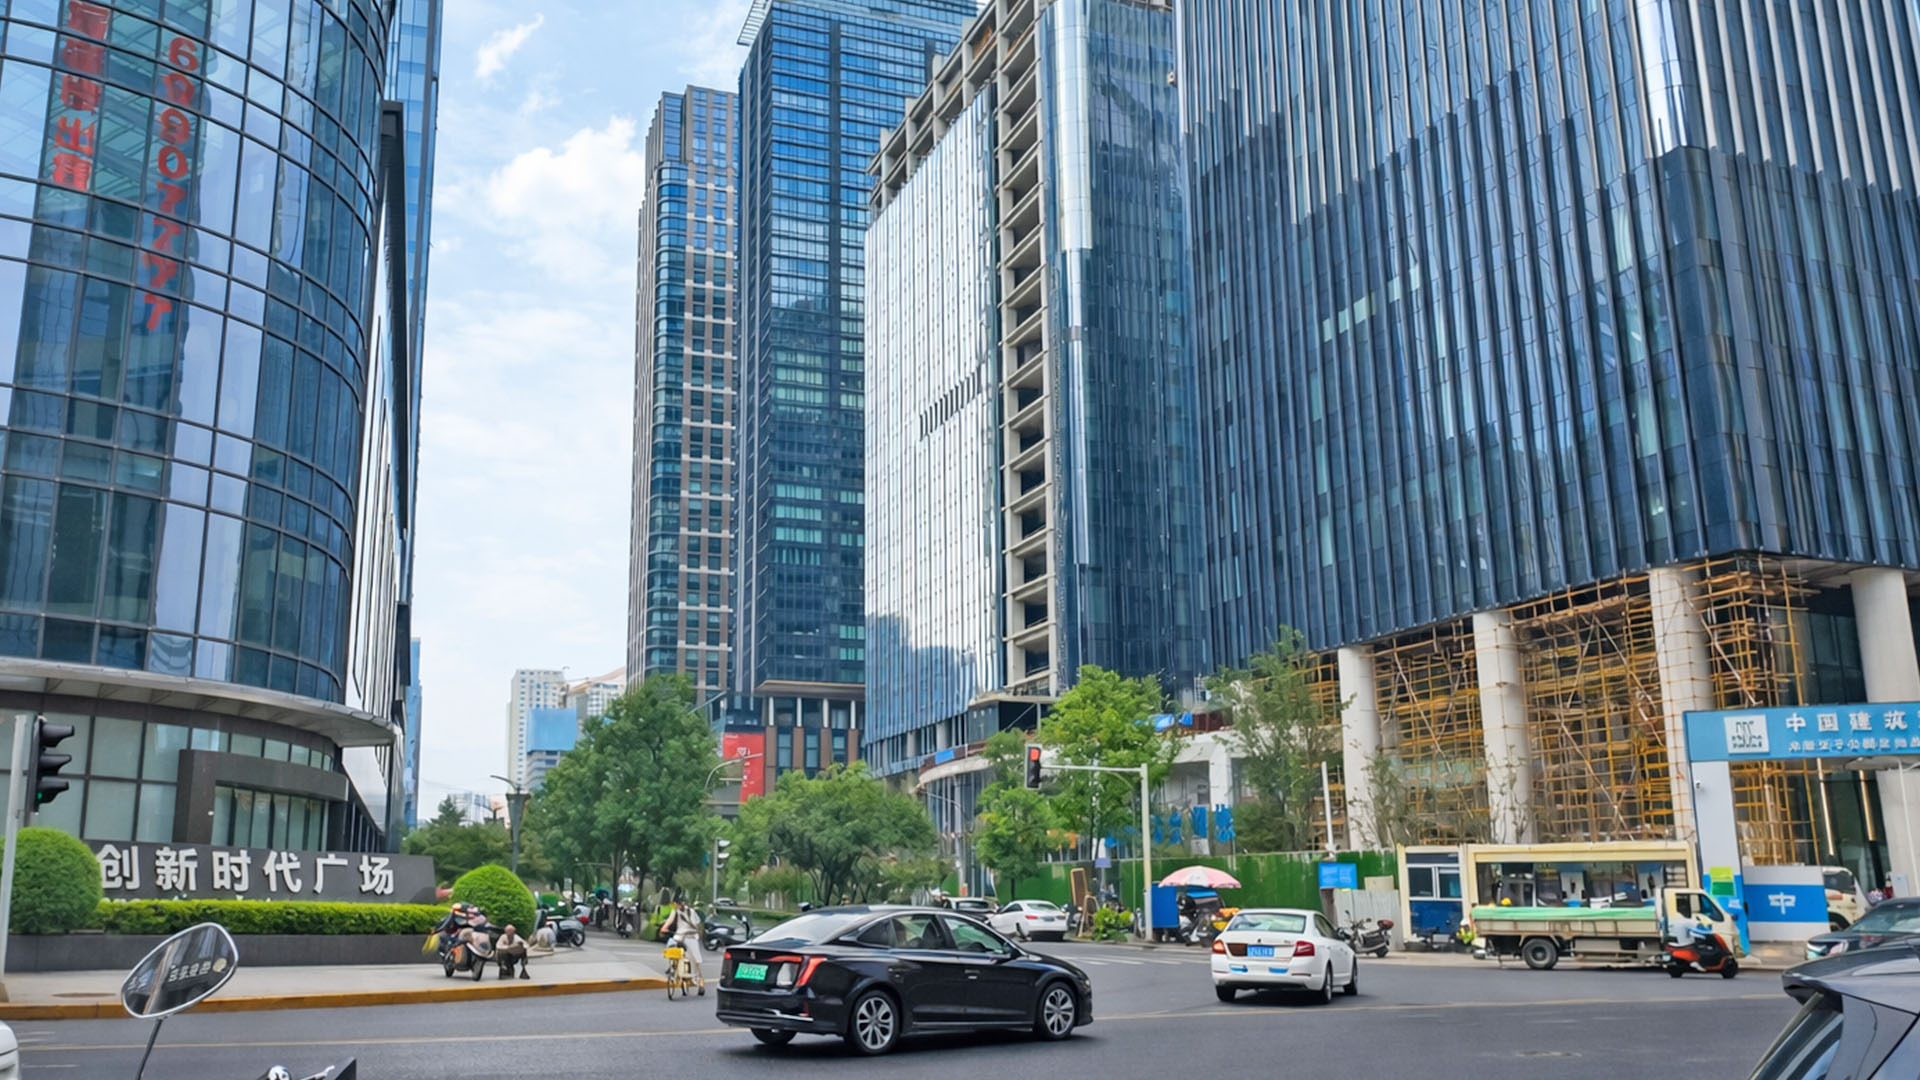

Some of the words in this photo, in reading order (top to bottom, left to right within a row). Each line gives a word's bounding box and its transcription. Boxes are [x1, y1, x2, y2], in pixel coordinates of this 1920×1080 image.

[1785, 709, 1920, 733] 中国建筑
[97, 843, 396, 896] 创新时代广场
